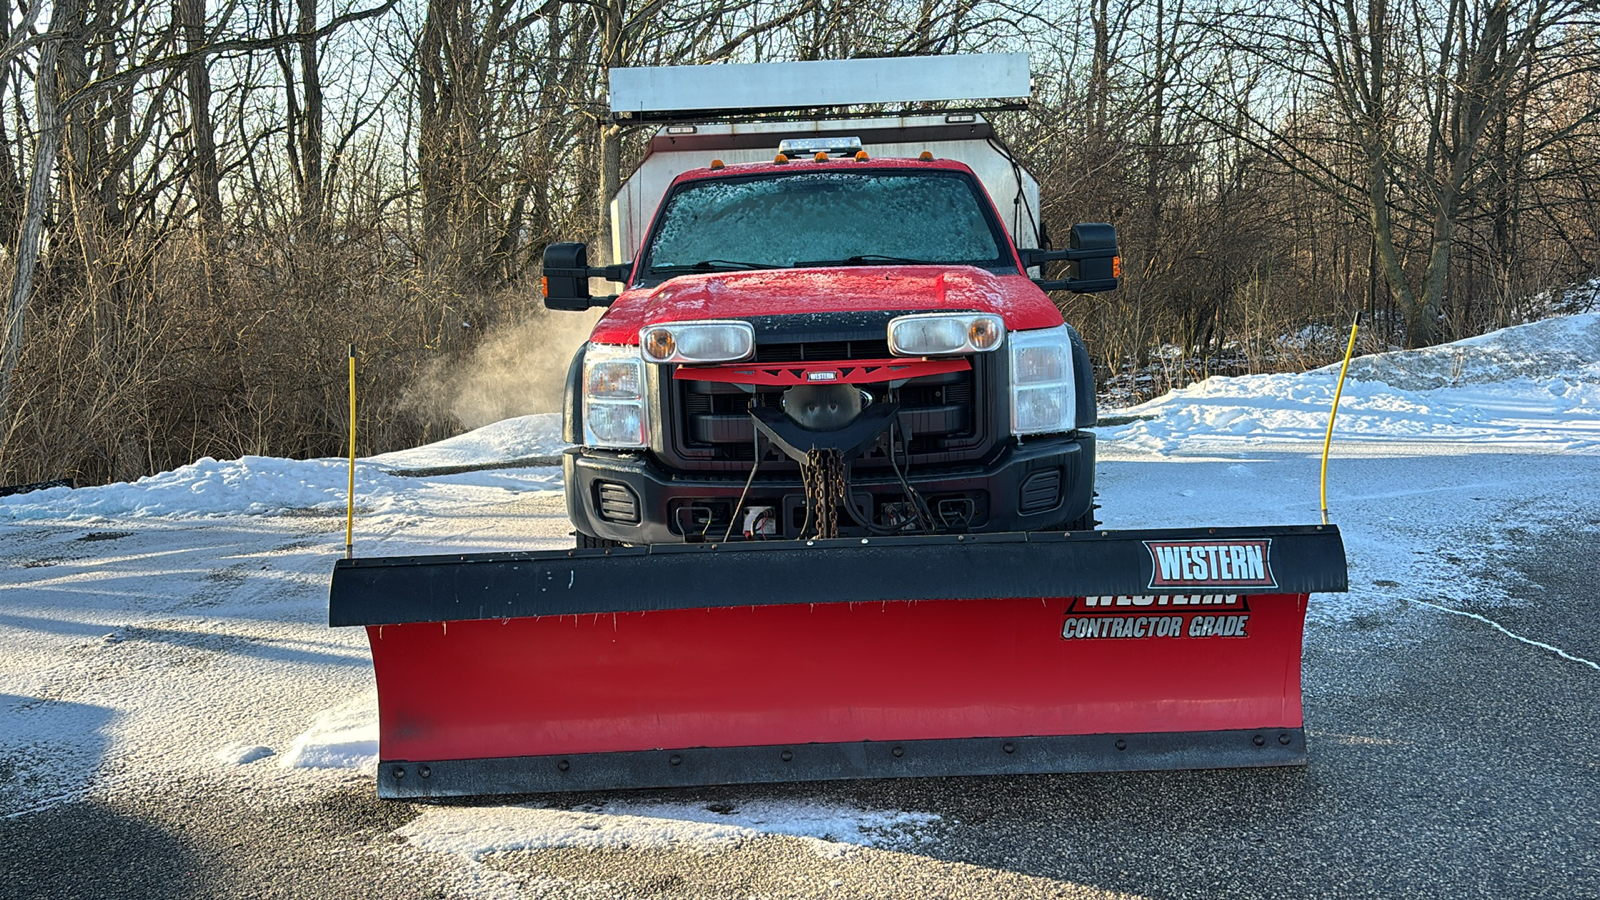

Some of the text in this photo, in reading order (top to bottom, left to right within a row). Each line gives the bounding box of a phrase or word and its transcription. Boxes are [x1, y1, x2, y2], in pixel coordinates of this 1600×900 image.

[810, 372, 835, 380] WESTERN
[1155, 545, 1265, 580] WESTERN
[1062, 615, 1250, 639] CONTRACTOR GRADE
